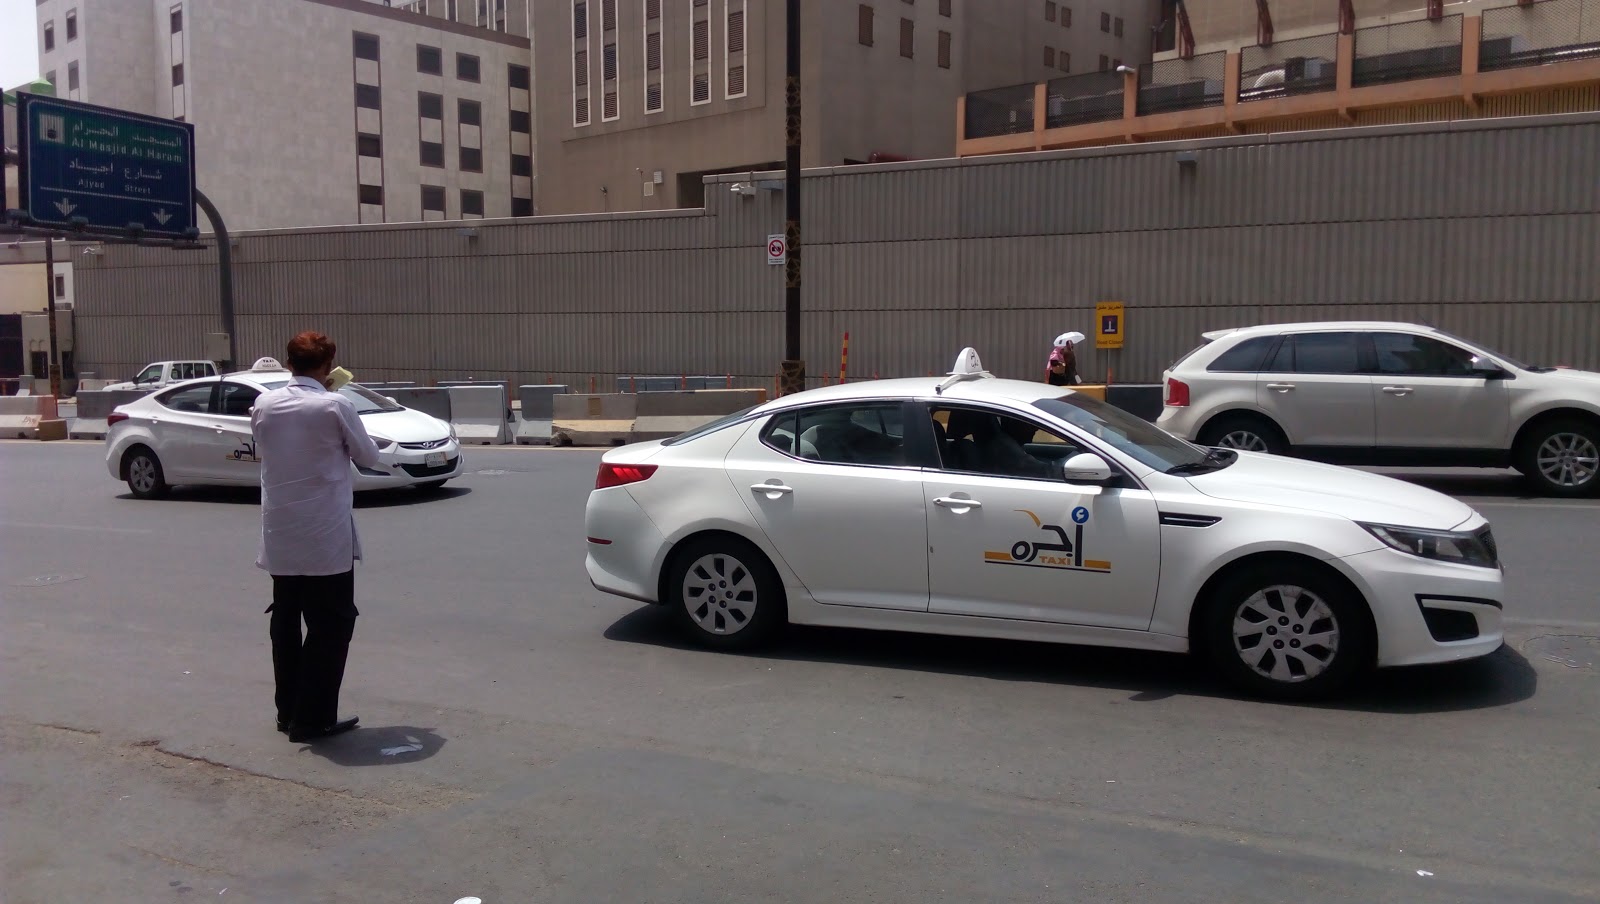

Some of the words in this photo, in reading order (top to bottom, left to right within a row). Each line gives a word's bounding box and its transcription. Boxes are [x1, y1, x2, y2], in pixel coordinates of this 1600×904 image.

[72, 120, 119, 137] الحرام
[131, 134, 183, 148] المسجد
[71, 137, 84, 149] Al
[89, 140, 127, 156] Masjid
[131, 147, 143, 158] Al
[147, 149, 182, 163] Haram
[78, 178, 105, 190] Ajyad
[124, 184, 151, 195] Street
[1039, 556, 1071, 566] TAXI
